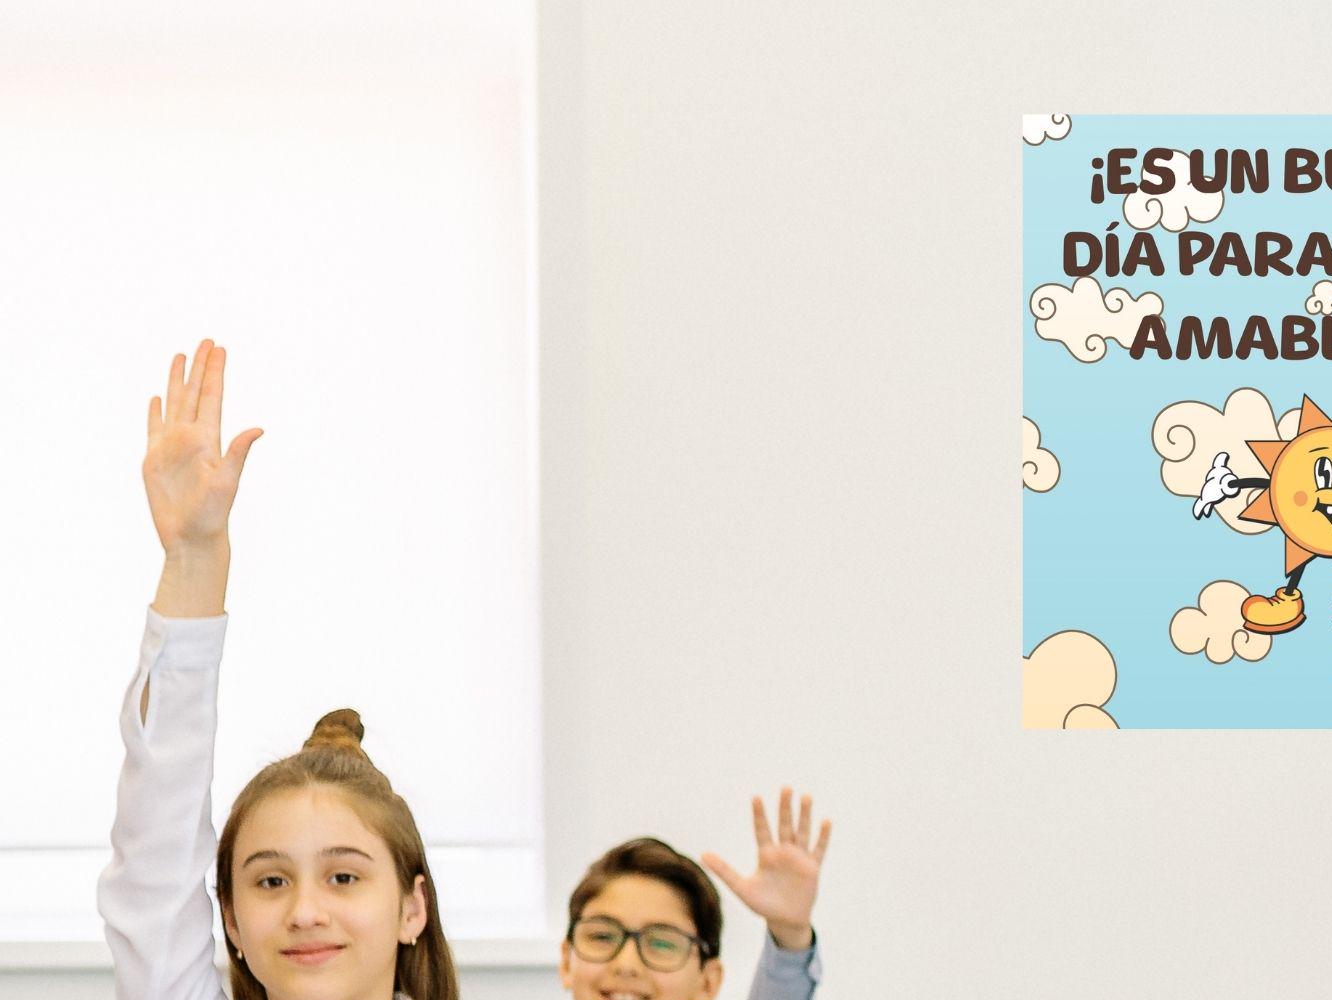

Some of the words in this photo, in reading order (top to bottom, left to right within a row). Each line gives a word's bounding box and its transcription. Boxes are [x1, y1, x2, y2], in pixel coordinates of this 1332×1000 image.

[1090, 147, 1176, 204] ¡ES
[1189, 148, 1269, 194] UN
[1063, 221, 1165, 277] DÍA
